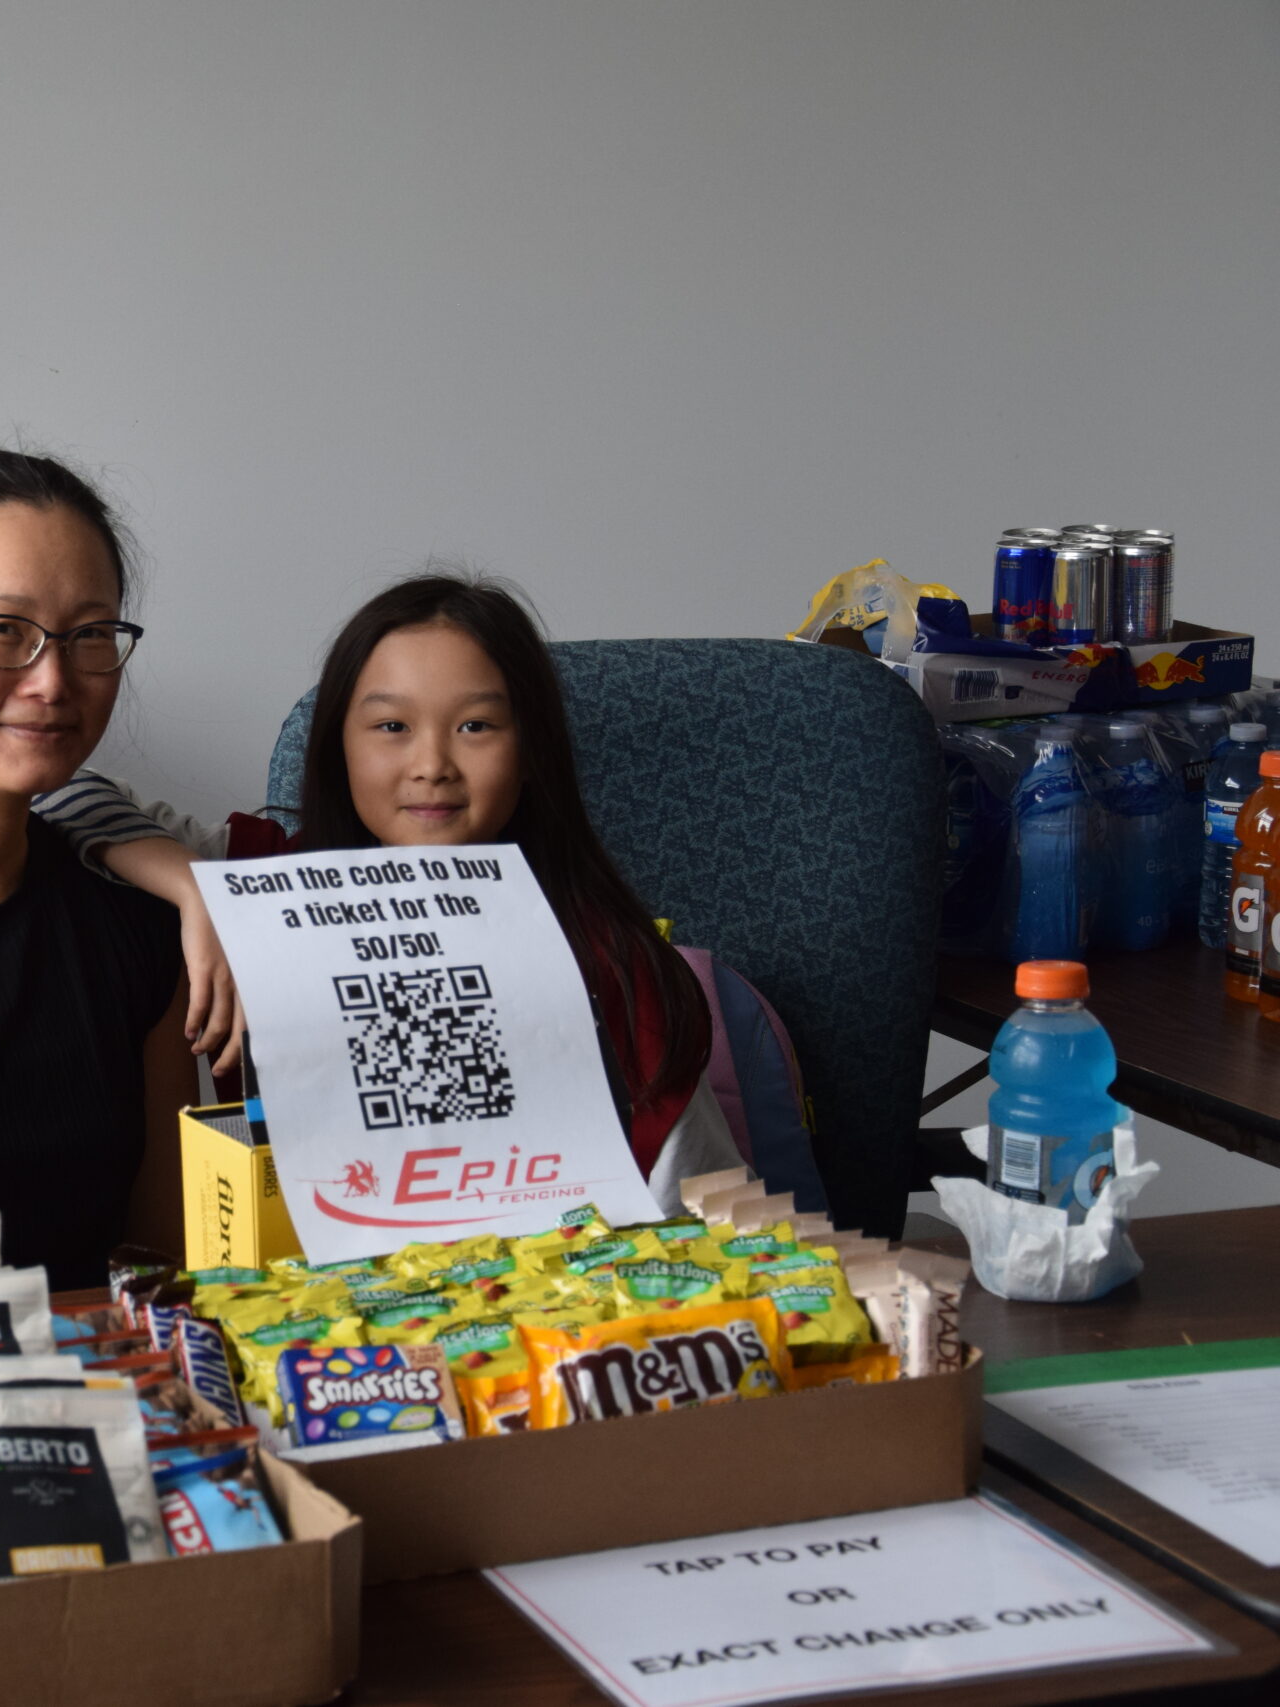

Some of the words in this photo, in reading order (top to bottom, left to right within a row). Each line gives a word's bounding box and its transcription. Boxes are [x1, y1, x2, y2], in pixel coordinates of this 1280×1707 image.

[1030, 669, 1089, 684] ENERG
[224, 869, 294, 896] Scan
[296, 865, 344, 891] the
[348, 859, 417, 887] code
[419, 857, 450, 881] to
[451, 856, 503, 882] buy
[282, 907, 302, 929] a
[304, 898, 388, 928] ticket
[390, 896, 430, 922] for
[434, 892, 482, 917] the
[1231, 886, 1261, 934] G
[351, 931, 446, 963] 50/50!
[263, 1155, 279, 1199] BARRES
[498, 1186, 587, 1205] FENCING
[617, 1260, 722, 1284] Fruitsations
[936, 1289, 961, 1375] MADE
[183, 1322, 241, 1427] SNICK
[644, 1556, 726, 1577] TAP
[734, 1548, 798, 1567] TO
[806, 1536, 883, 1559] PAY
[786, 1586, 857, 1606] OR
[631, 1639, 780, 1676] EXACT
[794, 1615, 991, 1652] CHANGE
[995, 1596, 1112, 1627] ONLY
